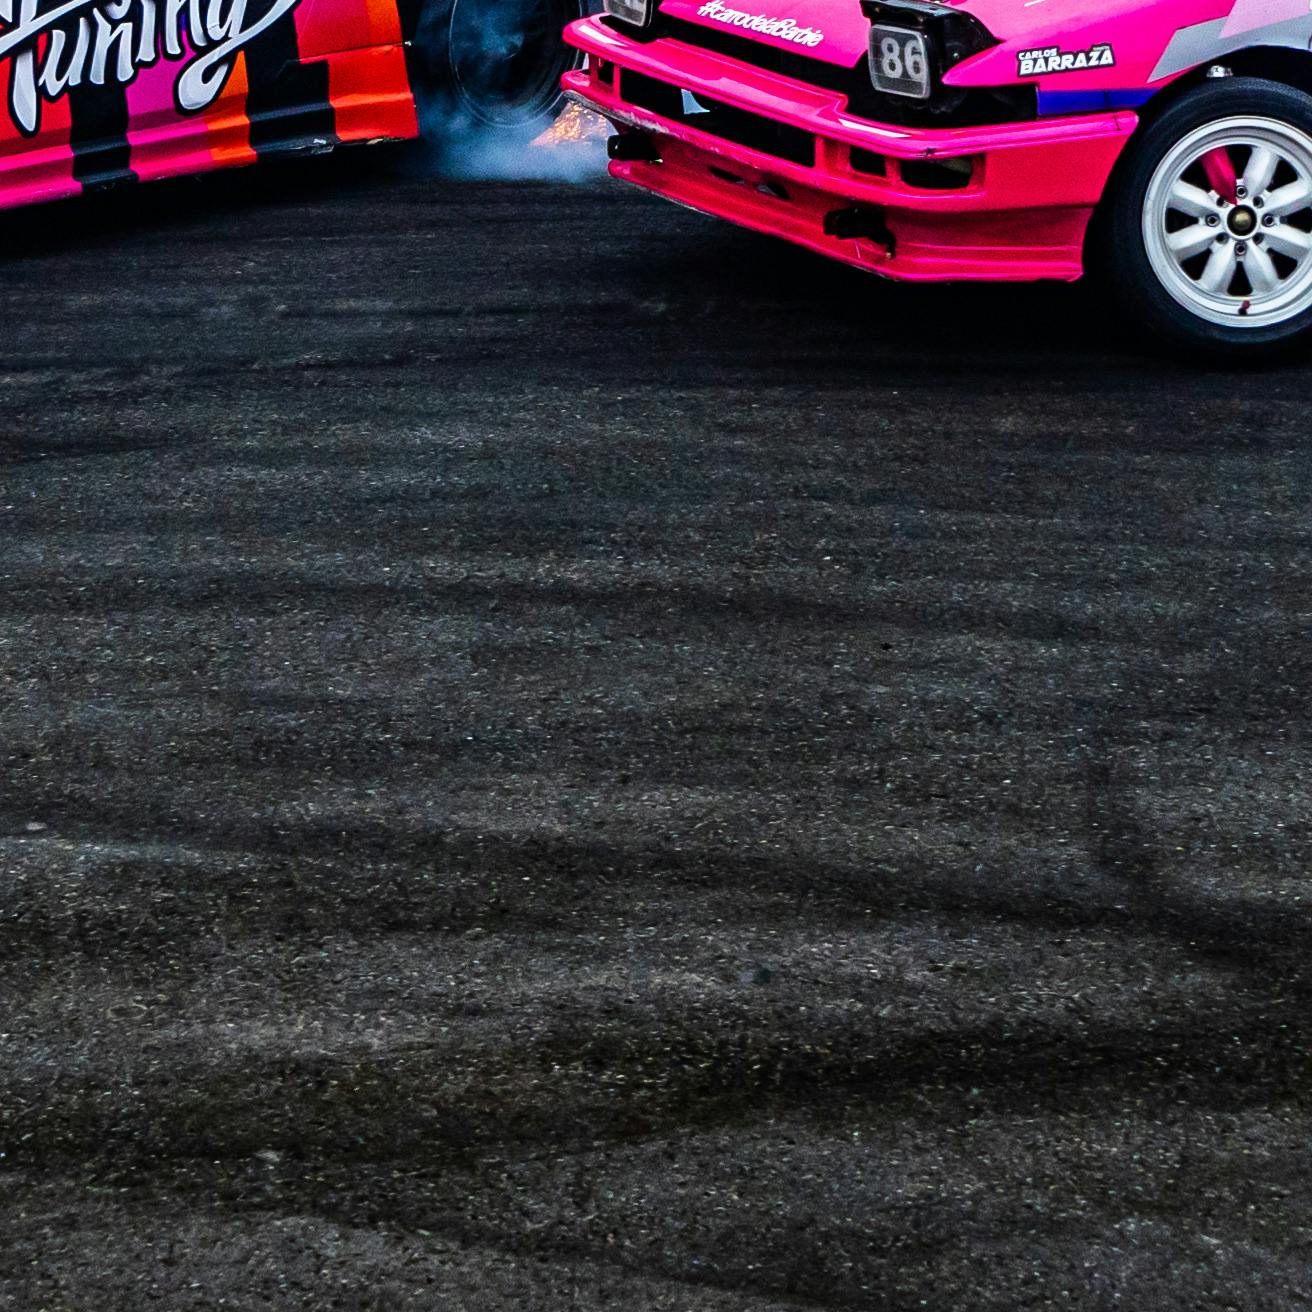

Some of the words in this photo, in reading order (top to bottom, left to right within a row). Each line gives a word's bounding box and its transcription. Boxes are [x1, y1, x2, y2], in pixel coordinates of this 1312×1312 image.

[880, 36, 926, 83] 86
[1018, 48, 1058, 60] CARLOS
[1019, 50, 1114, 76] BARRAZA
